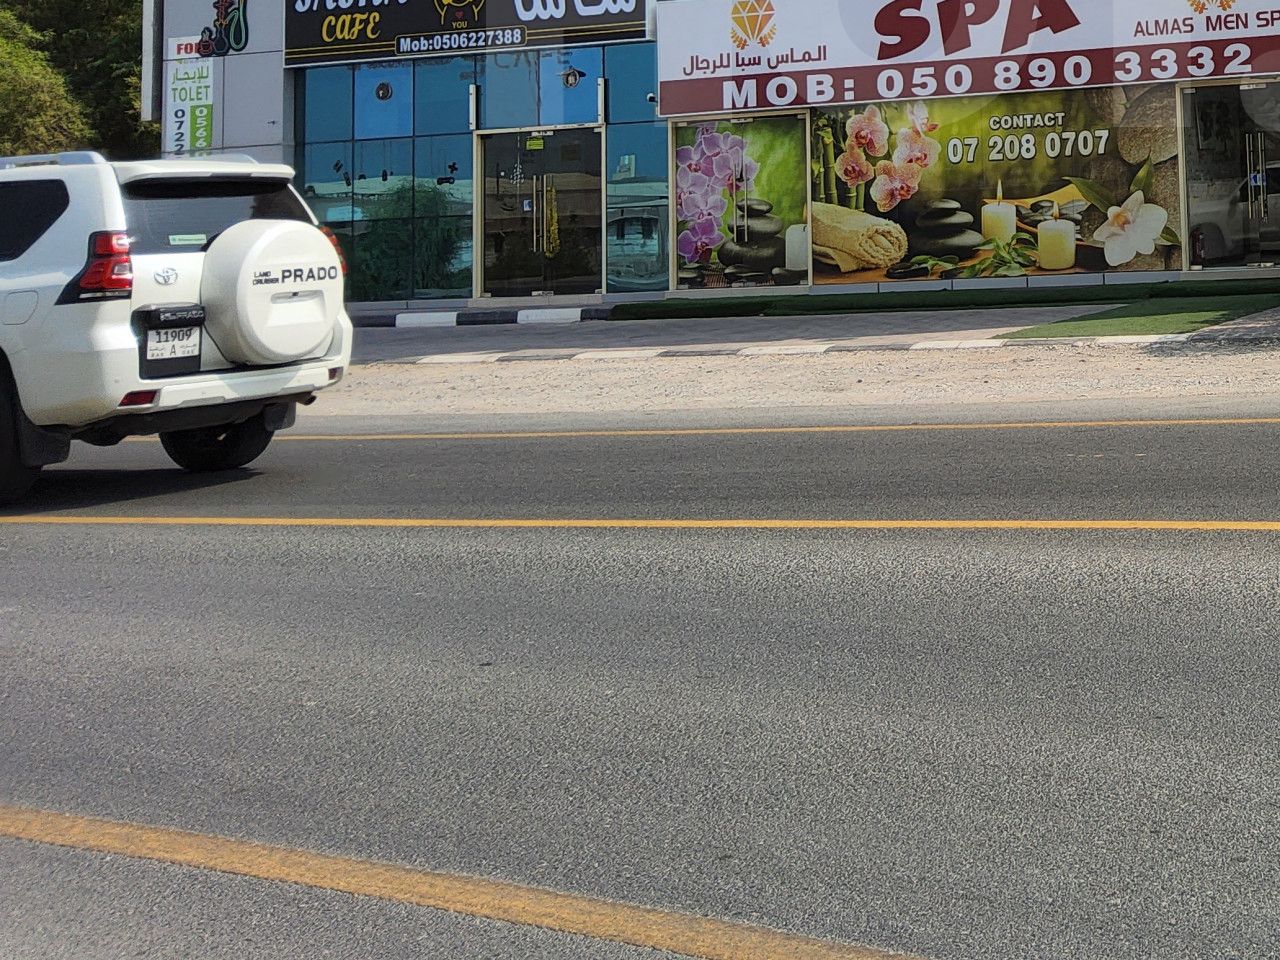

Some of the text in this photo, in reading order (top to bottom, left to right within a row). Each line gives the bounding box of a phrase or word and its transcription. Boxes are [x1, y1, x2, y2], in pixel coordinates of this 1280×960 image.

[322, 11, 381, 42] CAFE
[451, 20, 468, 29] YOU
[1133, 17, 1194, 37] ALMAS
[1205, 11, 1249, 32] MEN
[176, 42, 201, 55] FO
[400, 28, 522, 52] Mob:0506227388
[683, 45, 827, 76] الماس سبا للرجال
[722, 42, 1253, 110] MOB: 050 890 3332
[173, 108, 187, 157] 0722
[194, 107, 208, 154] 0566
[989, 112, 1066, 131] CONTACT
[947, 129, 1110, 163] 07 208 0707
[281, 266, 338, 284] PRADO
[169, 344, 177, 356] A
